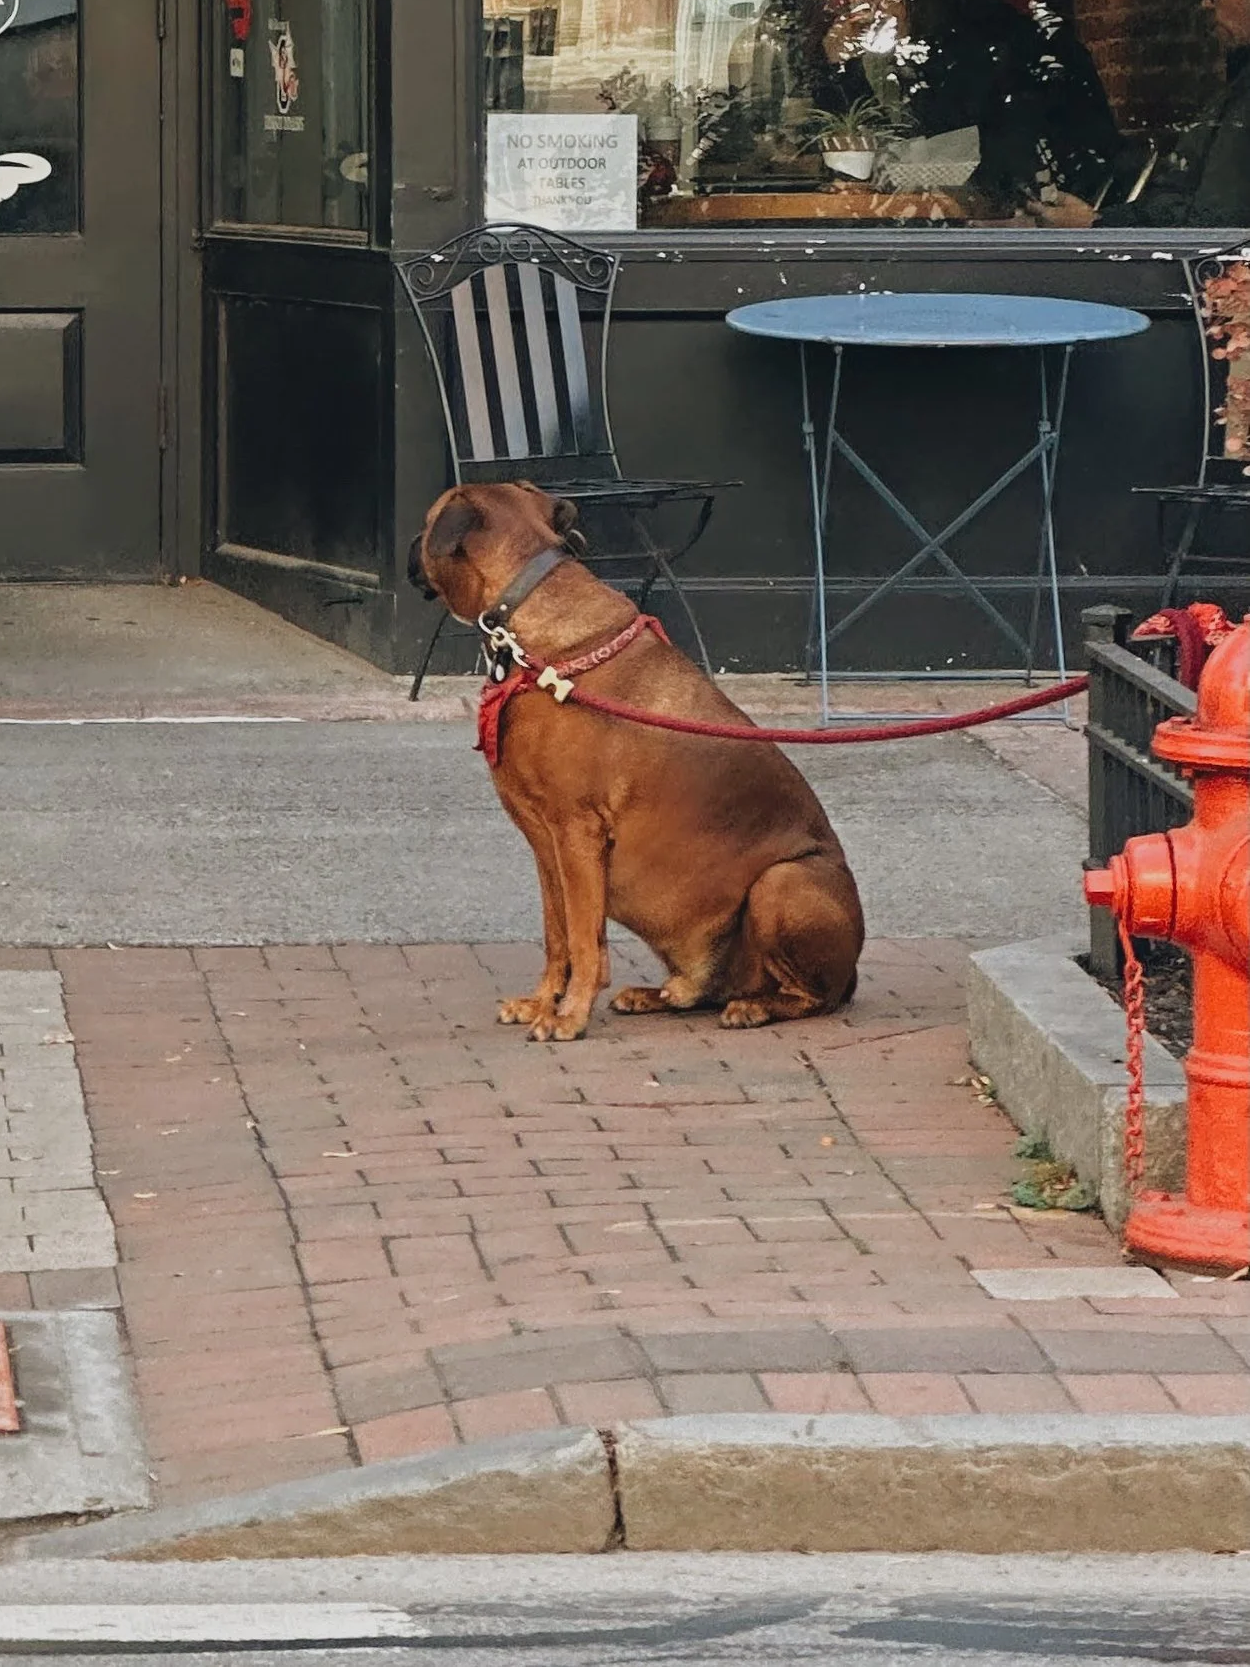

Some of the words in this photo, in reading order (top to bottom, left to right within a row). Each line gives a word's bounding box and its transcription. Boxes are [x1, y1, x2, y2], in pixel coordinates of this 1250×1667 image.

[507, 134, 533, 149] NO
[537, 134, 618, 149] SMOKING
[517, 157, 535, 170] AT
[538, 157, 607, 170] OUTDOOR
[539, 177, 586, 189] TABLES
